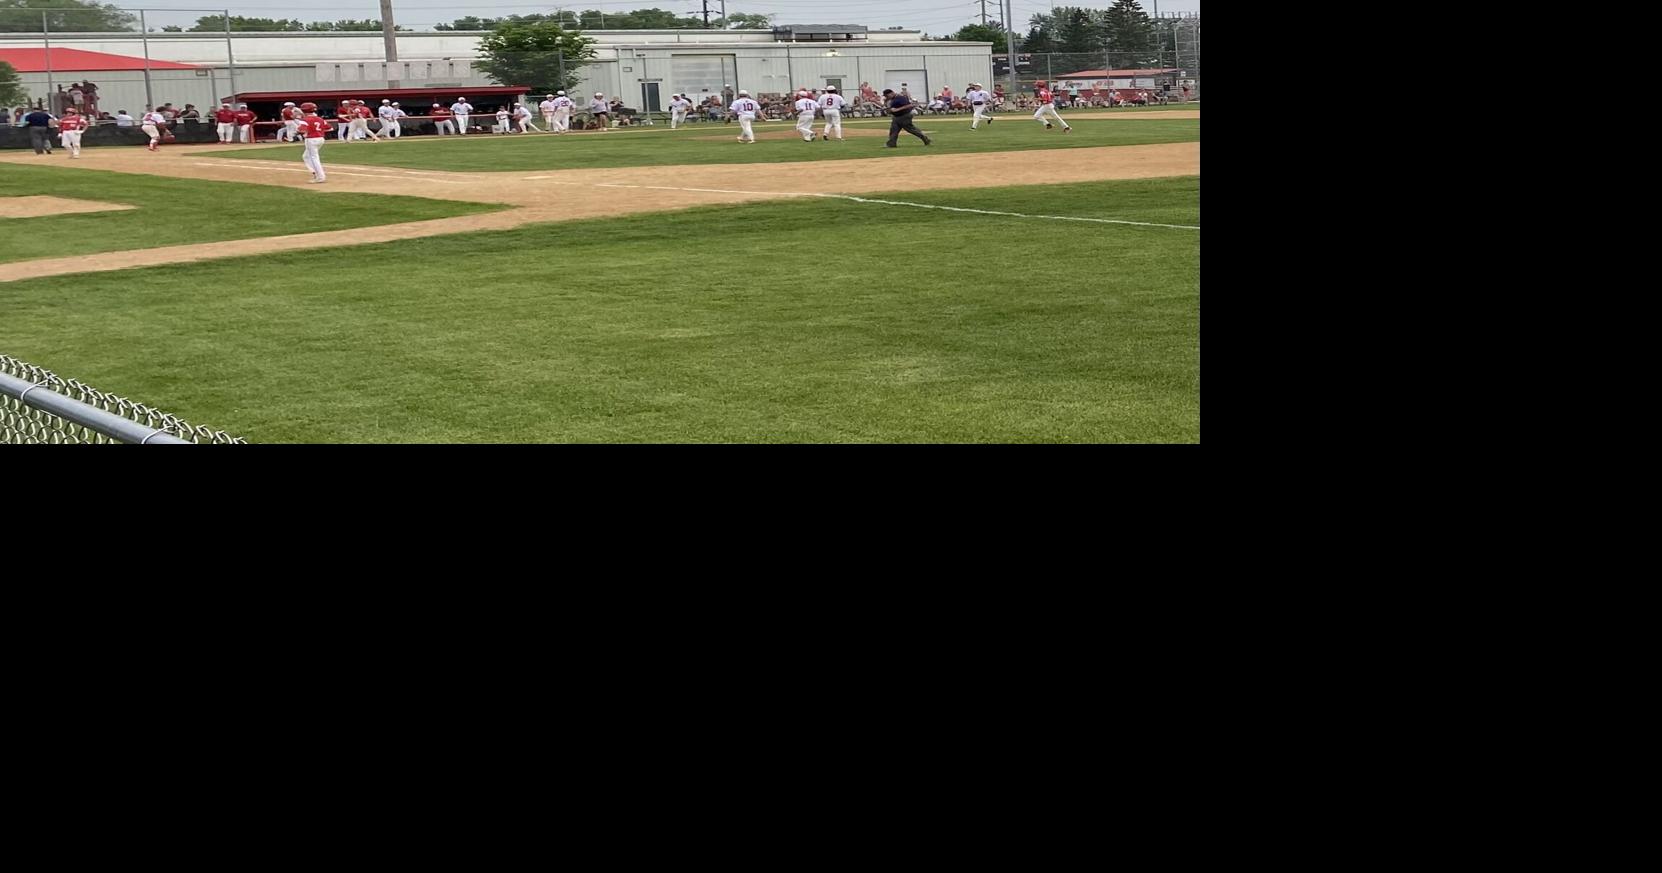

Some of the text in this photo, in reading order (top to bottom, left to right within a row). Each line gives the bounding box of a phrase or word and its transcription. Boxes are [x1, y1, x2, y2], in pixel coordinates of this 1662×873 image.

[826, 97, 834, 106] 8
[742, 102, 753, 111] 10
[805, 102, 812, 110] 11
[314, 122, 321, 130] 2
